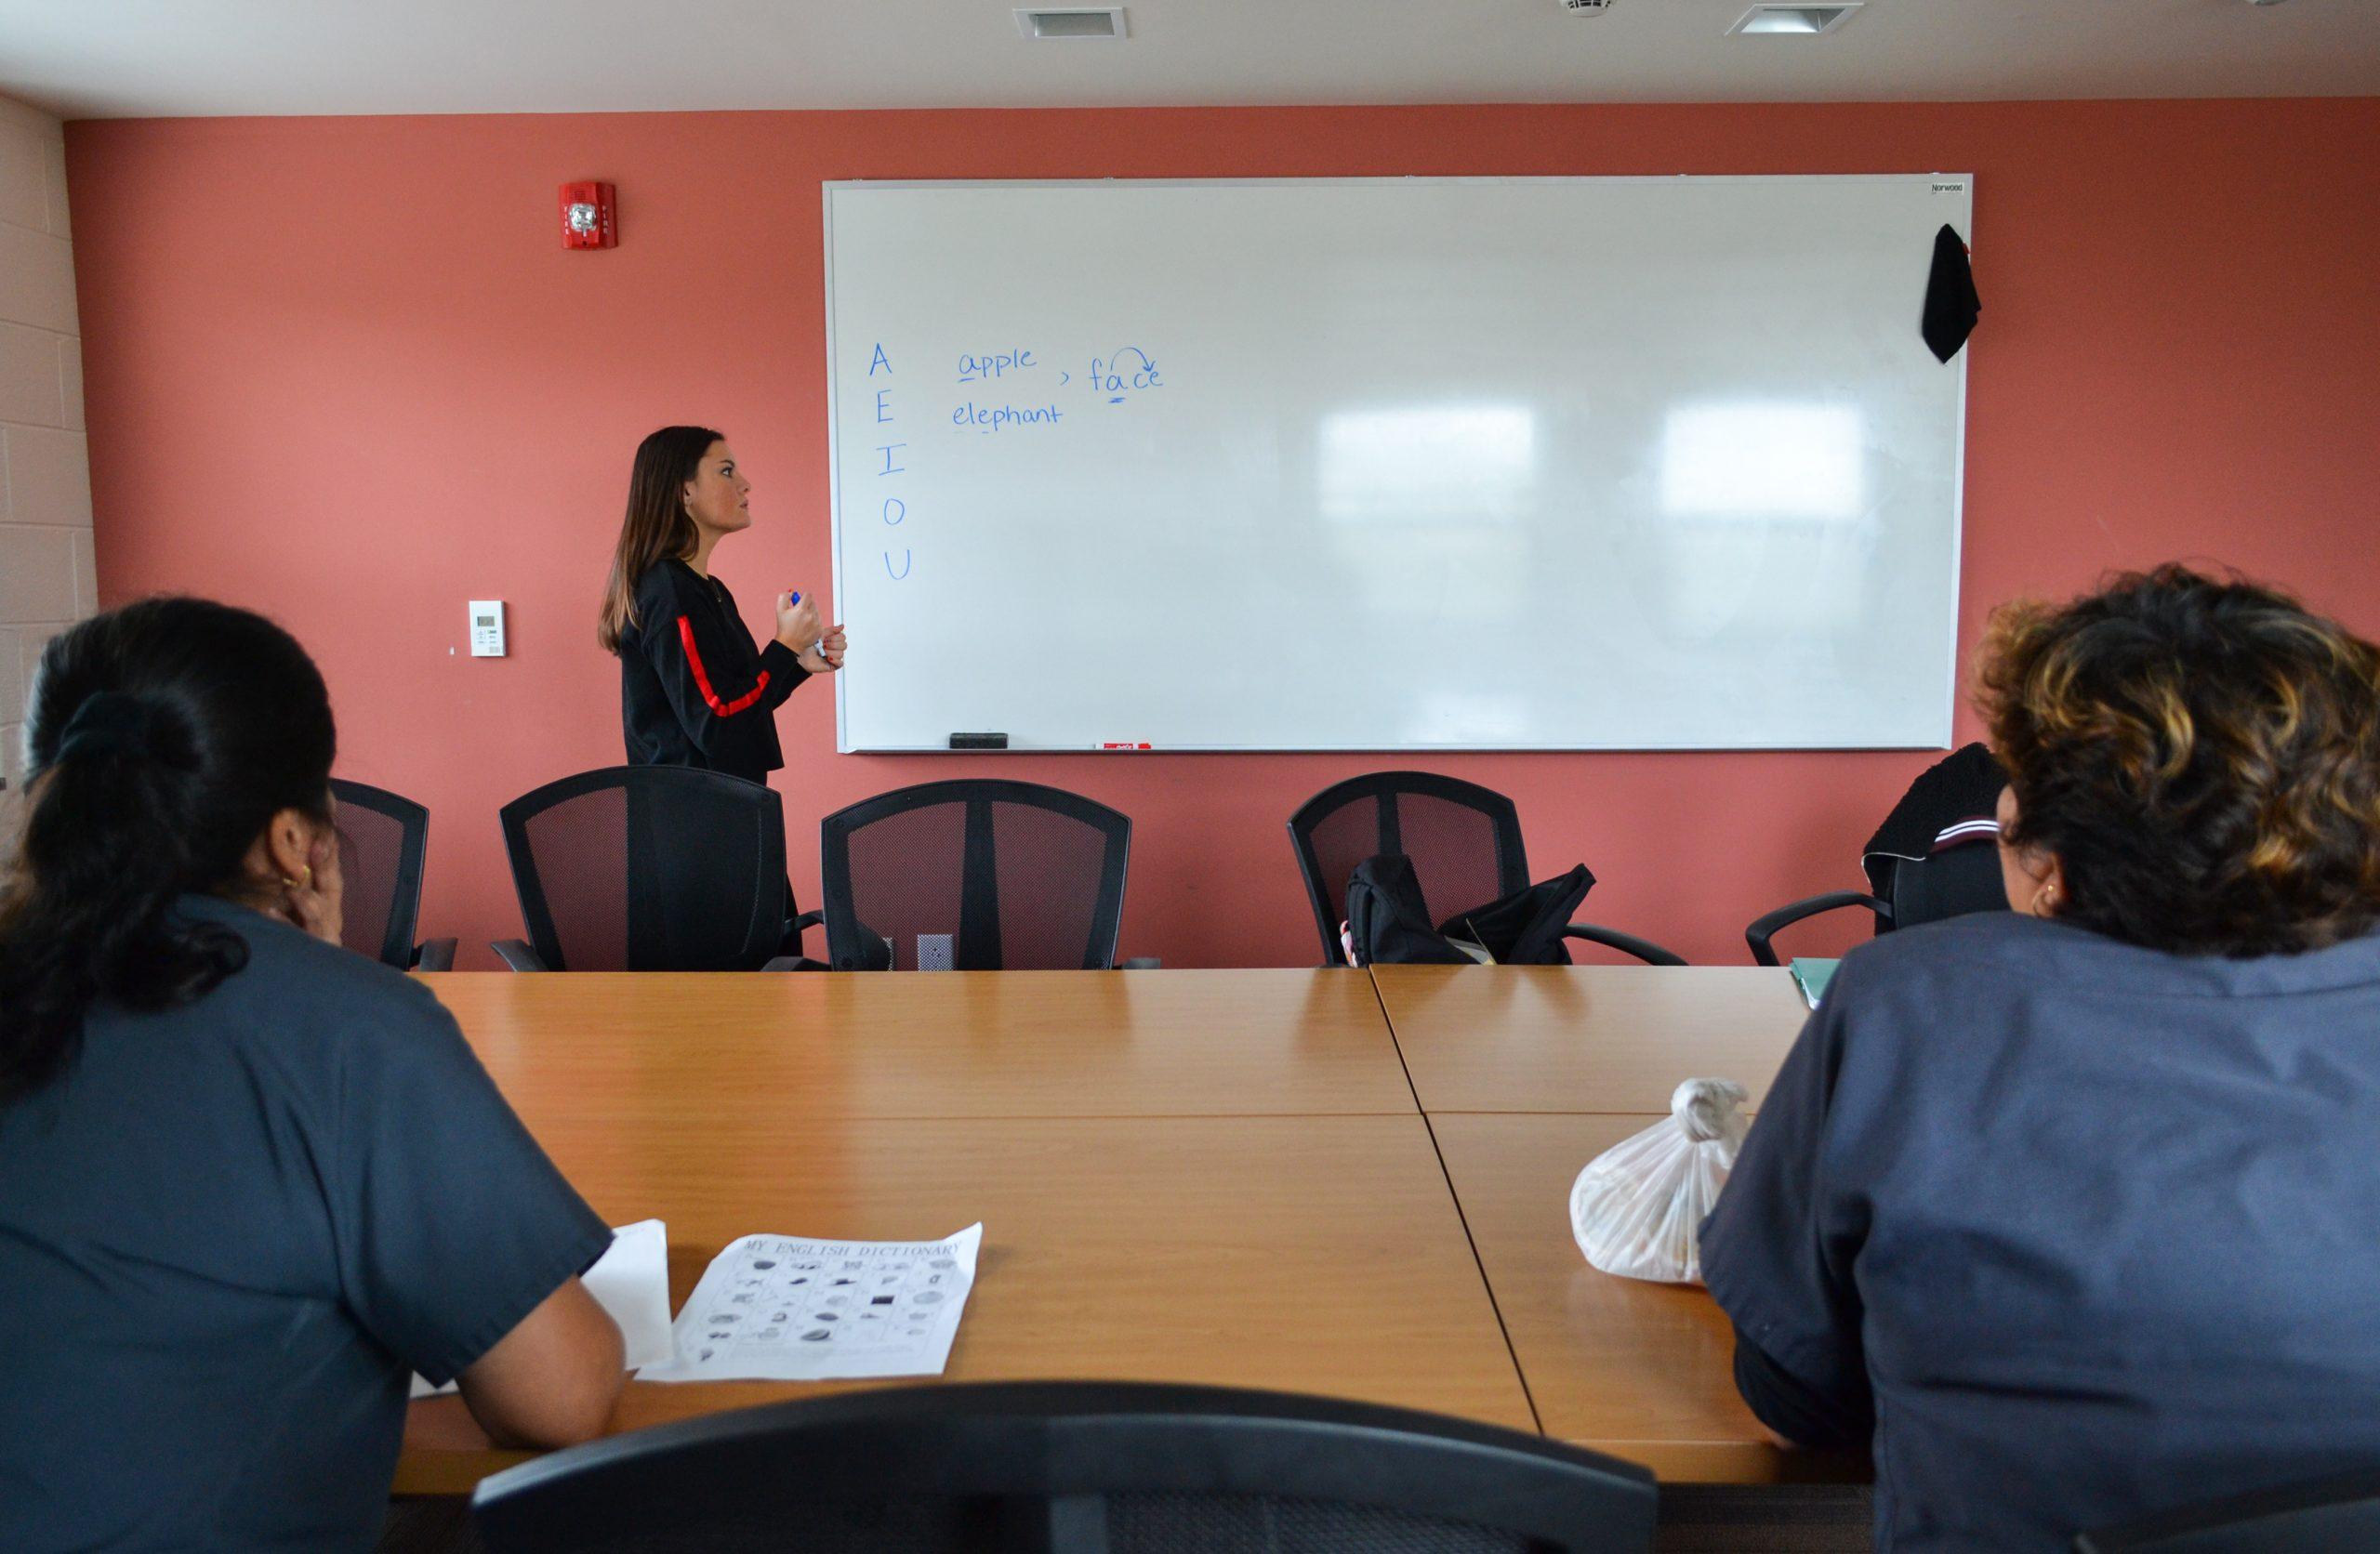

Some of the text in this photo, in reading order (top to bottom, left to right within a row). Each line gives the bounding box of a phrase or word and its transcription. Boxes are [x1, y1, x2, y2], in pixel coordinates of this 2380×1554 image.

[869, 342, 892, 375] A
[958, 349, 1038, 377] apple
[1089, 358, 1164, 391] face
[877, 388, 1064, 432] E elephant
[876, 443, 907, 476] I
[883, 498, 905, 526] O
[884, 548, 910, 580] U
[744, 1240, 960, 1256] MY ENGLISH DICTIONARY
